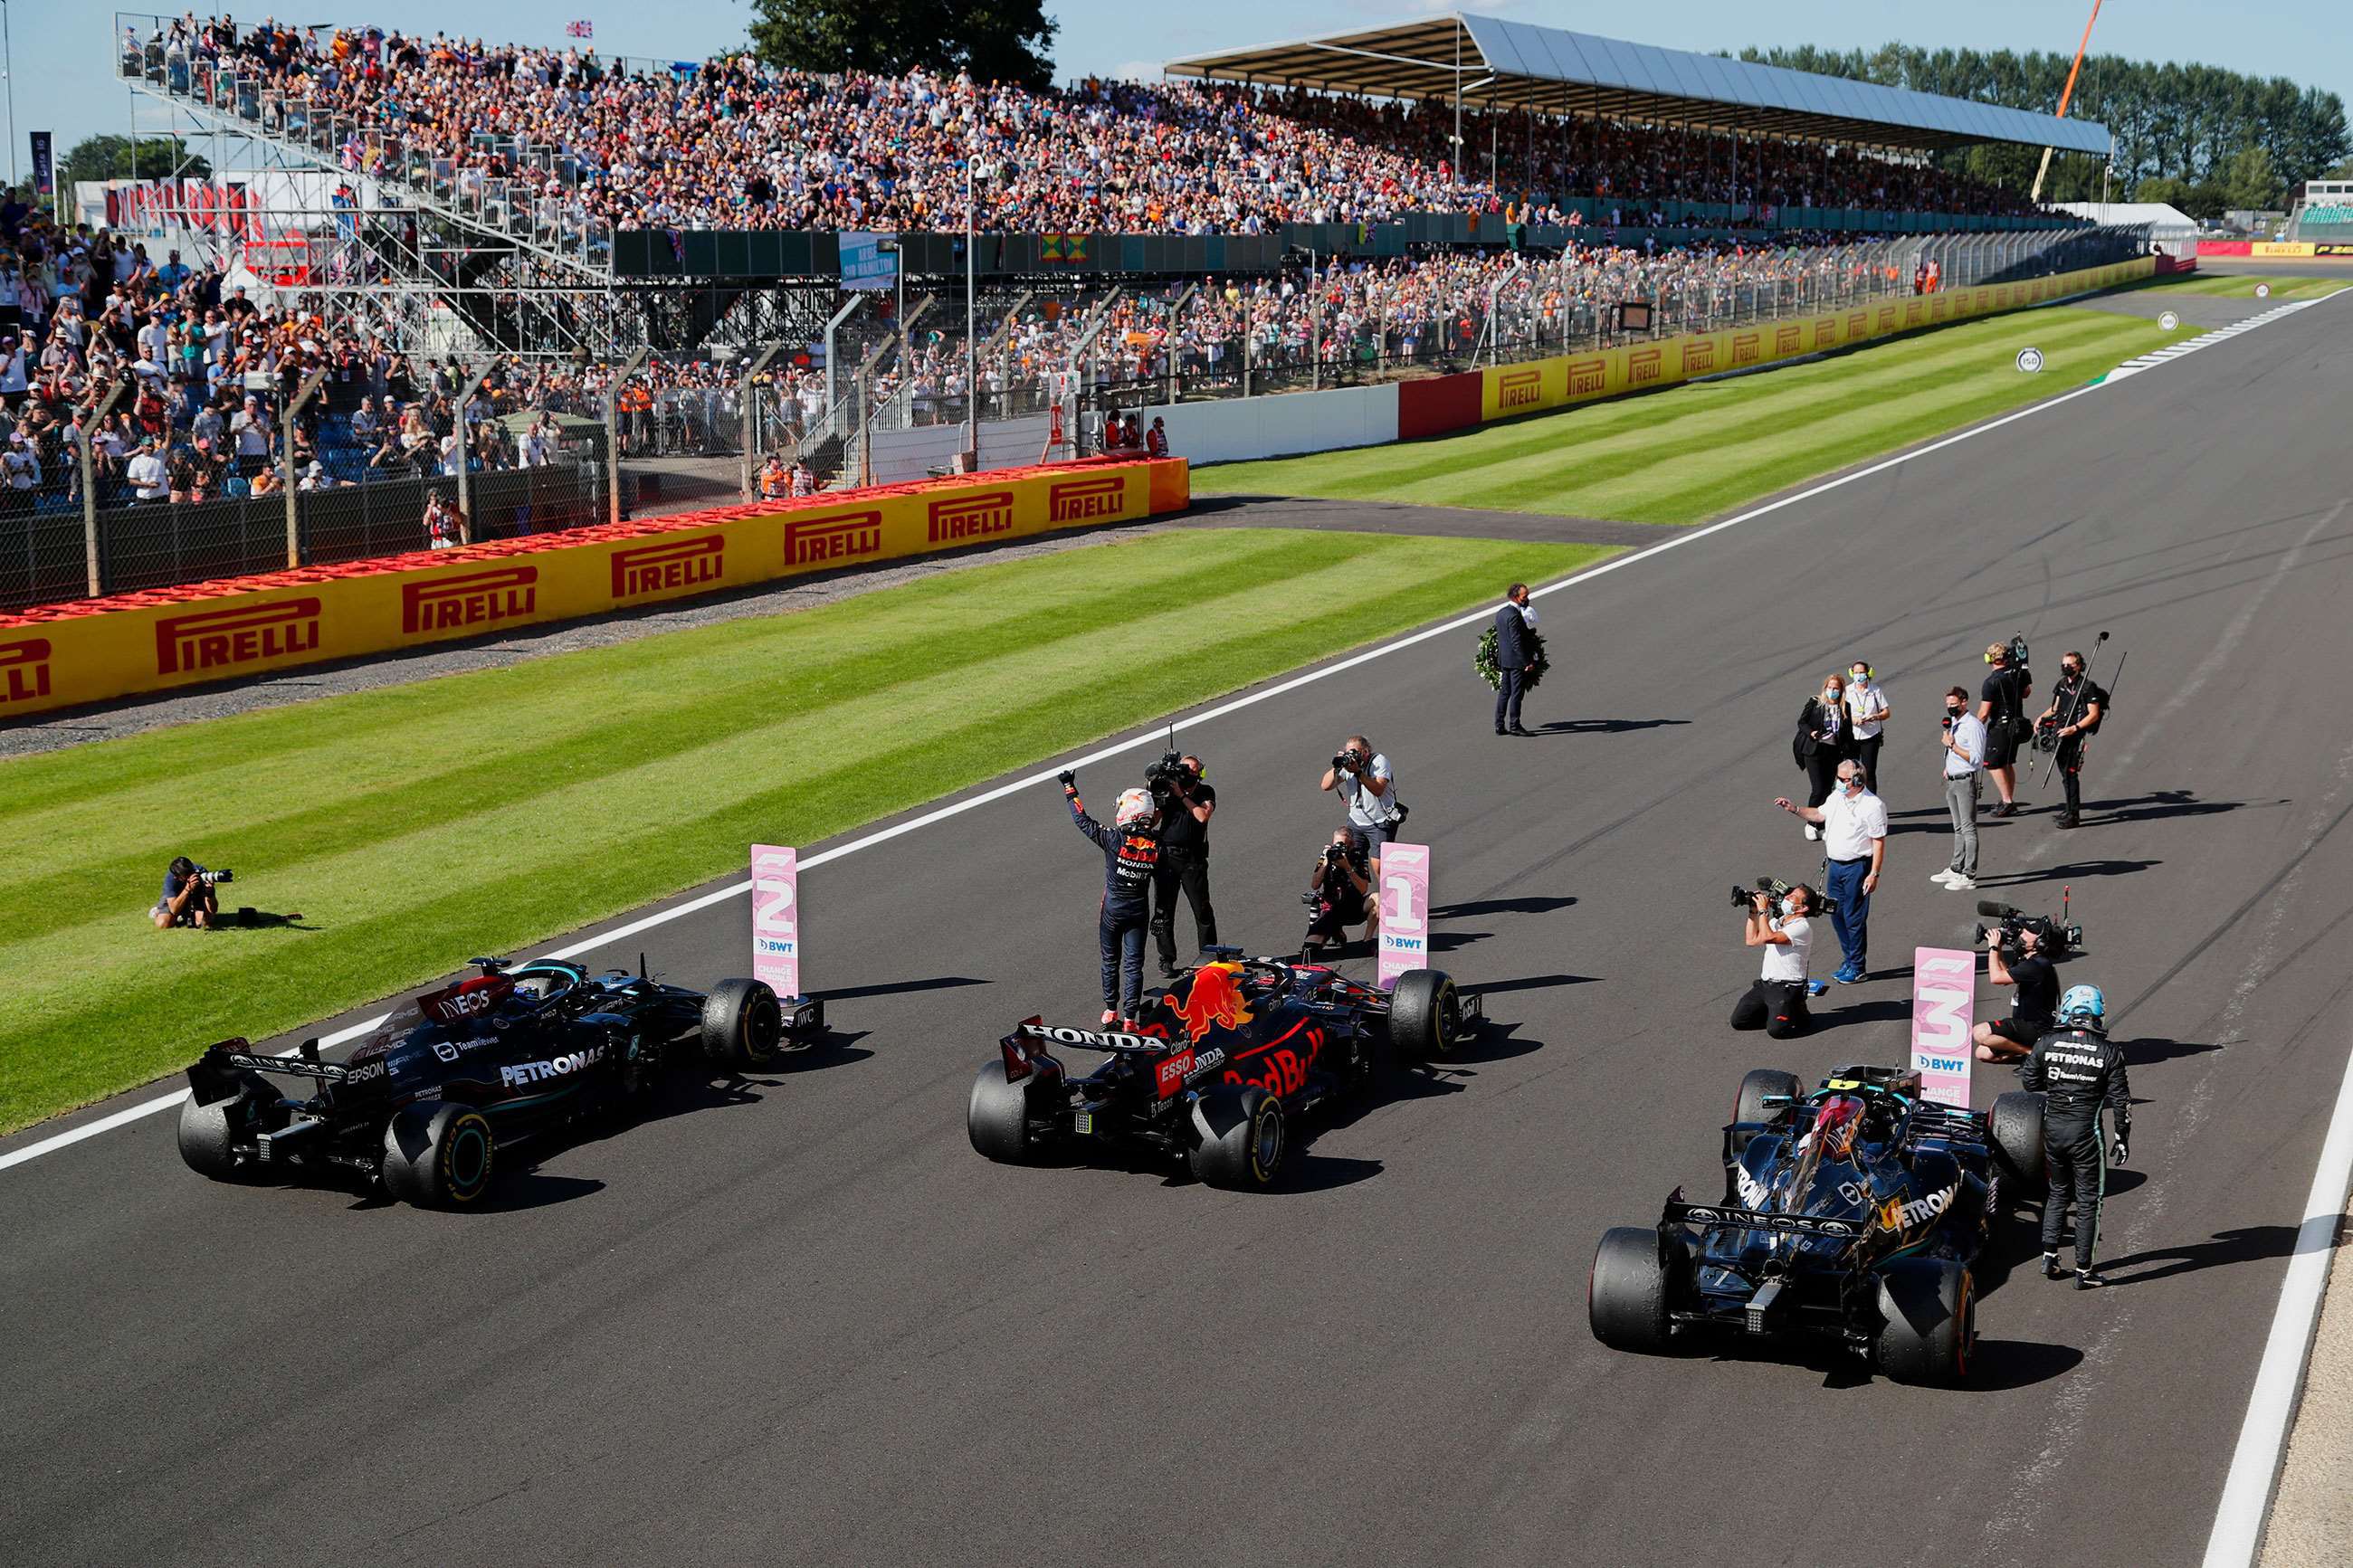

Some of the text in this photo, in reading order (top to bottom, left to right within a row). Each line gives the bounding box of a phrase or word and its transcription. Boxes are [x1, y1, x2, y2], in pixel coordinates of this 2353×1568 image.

[1628, 348, 1662, 384] PIRELLI
[1682, 341, 1713, 373] PIRELLI
[1500, 369, 1541, 408] PIRELLI
[1567, 359, 1605, 396] PIRELLI
[1049, 477, 1125, 522] PIRELLI
[927, 491, 1014, 543] PIRELLI
[784, 509, 881, 566] PIRELLI
[611, 534, 724, 598] PIRELLI
[402, 565, 538, 633] PIRELLI
[156, 596, 322, 675] PIRELLI
[1116, 856, 1154, 870] HONDA
[756, 879, 794, 933] 2
[1385, 876, 1423, 930] 1
[768, 940, 793, 953] BWT
[1396, 937, 1421, 949] BWT
[438, 990, 490, 1019] INEOS
[797, 1008, 814, 1028] IWC
[1918, 986, 1969, 1049] 3
[457, 1036, 500, 1052] TeamViewer
[1024, 1024, 1167, 1050] HONDA
[254, 1057, 319, 1074] INEOS
[348, 1060, 386, 1085] EPSON
[500, 1045, 605, 1087] PETRONAS
[1161, 1055, 1190, 1083] ESSO
[1931, 1058, 1964, 1071] BWT
[2044, 1051, 2104, 1068] PETRONAS
[2060, 1071, 2098, 1082] TeamViewer
[1724, 1211, 1814, 1230] INEOS
[1891, 1182, 1958, 1232] PETRON
